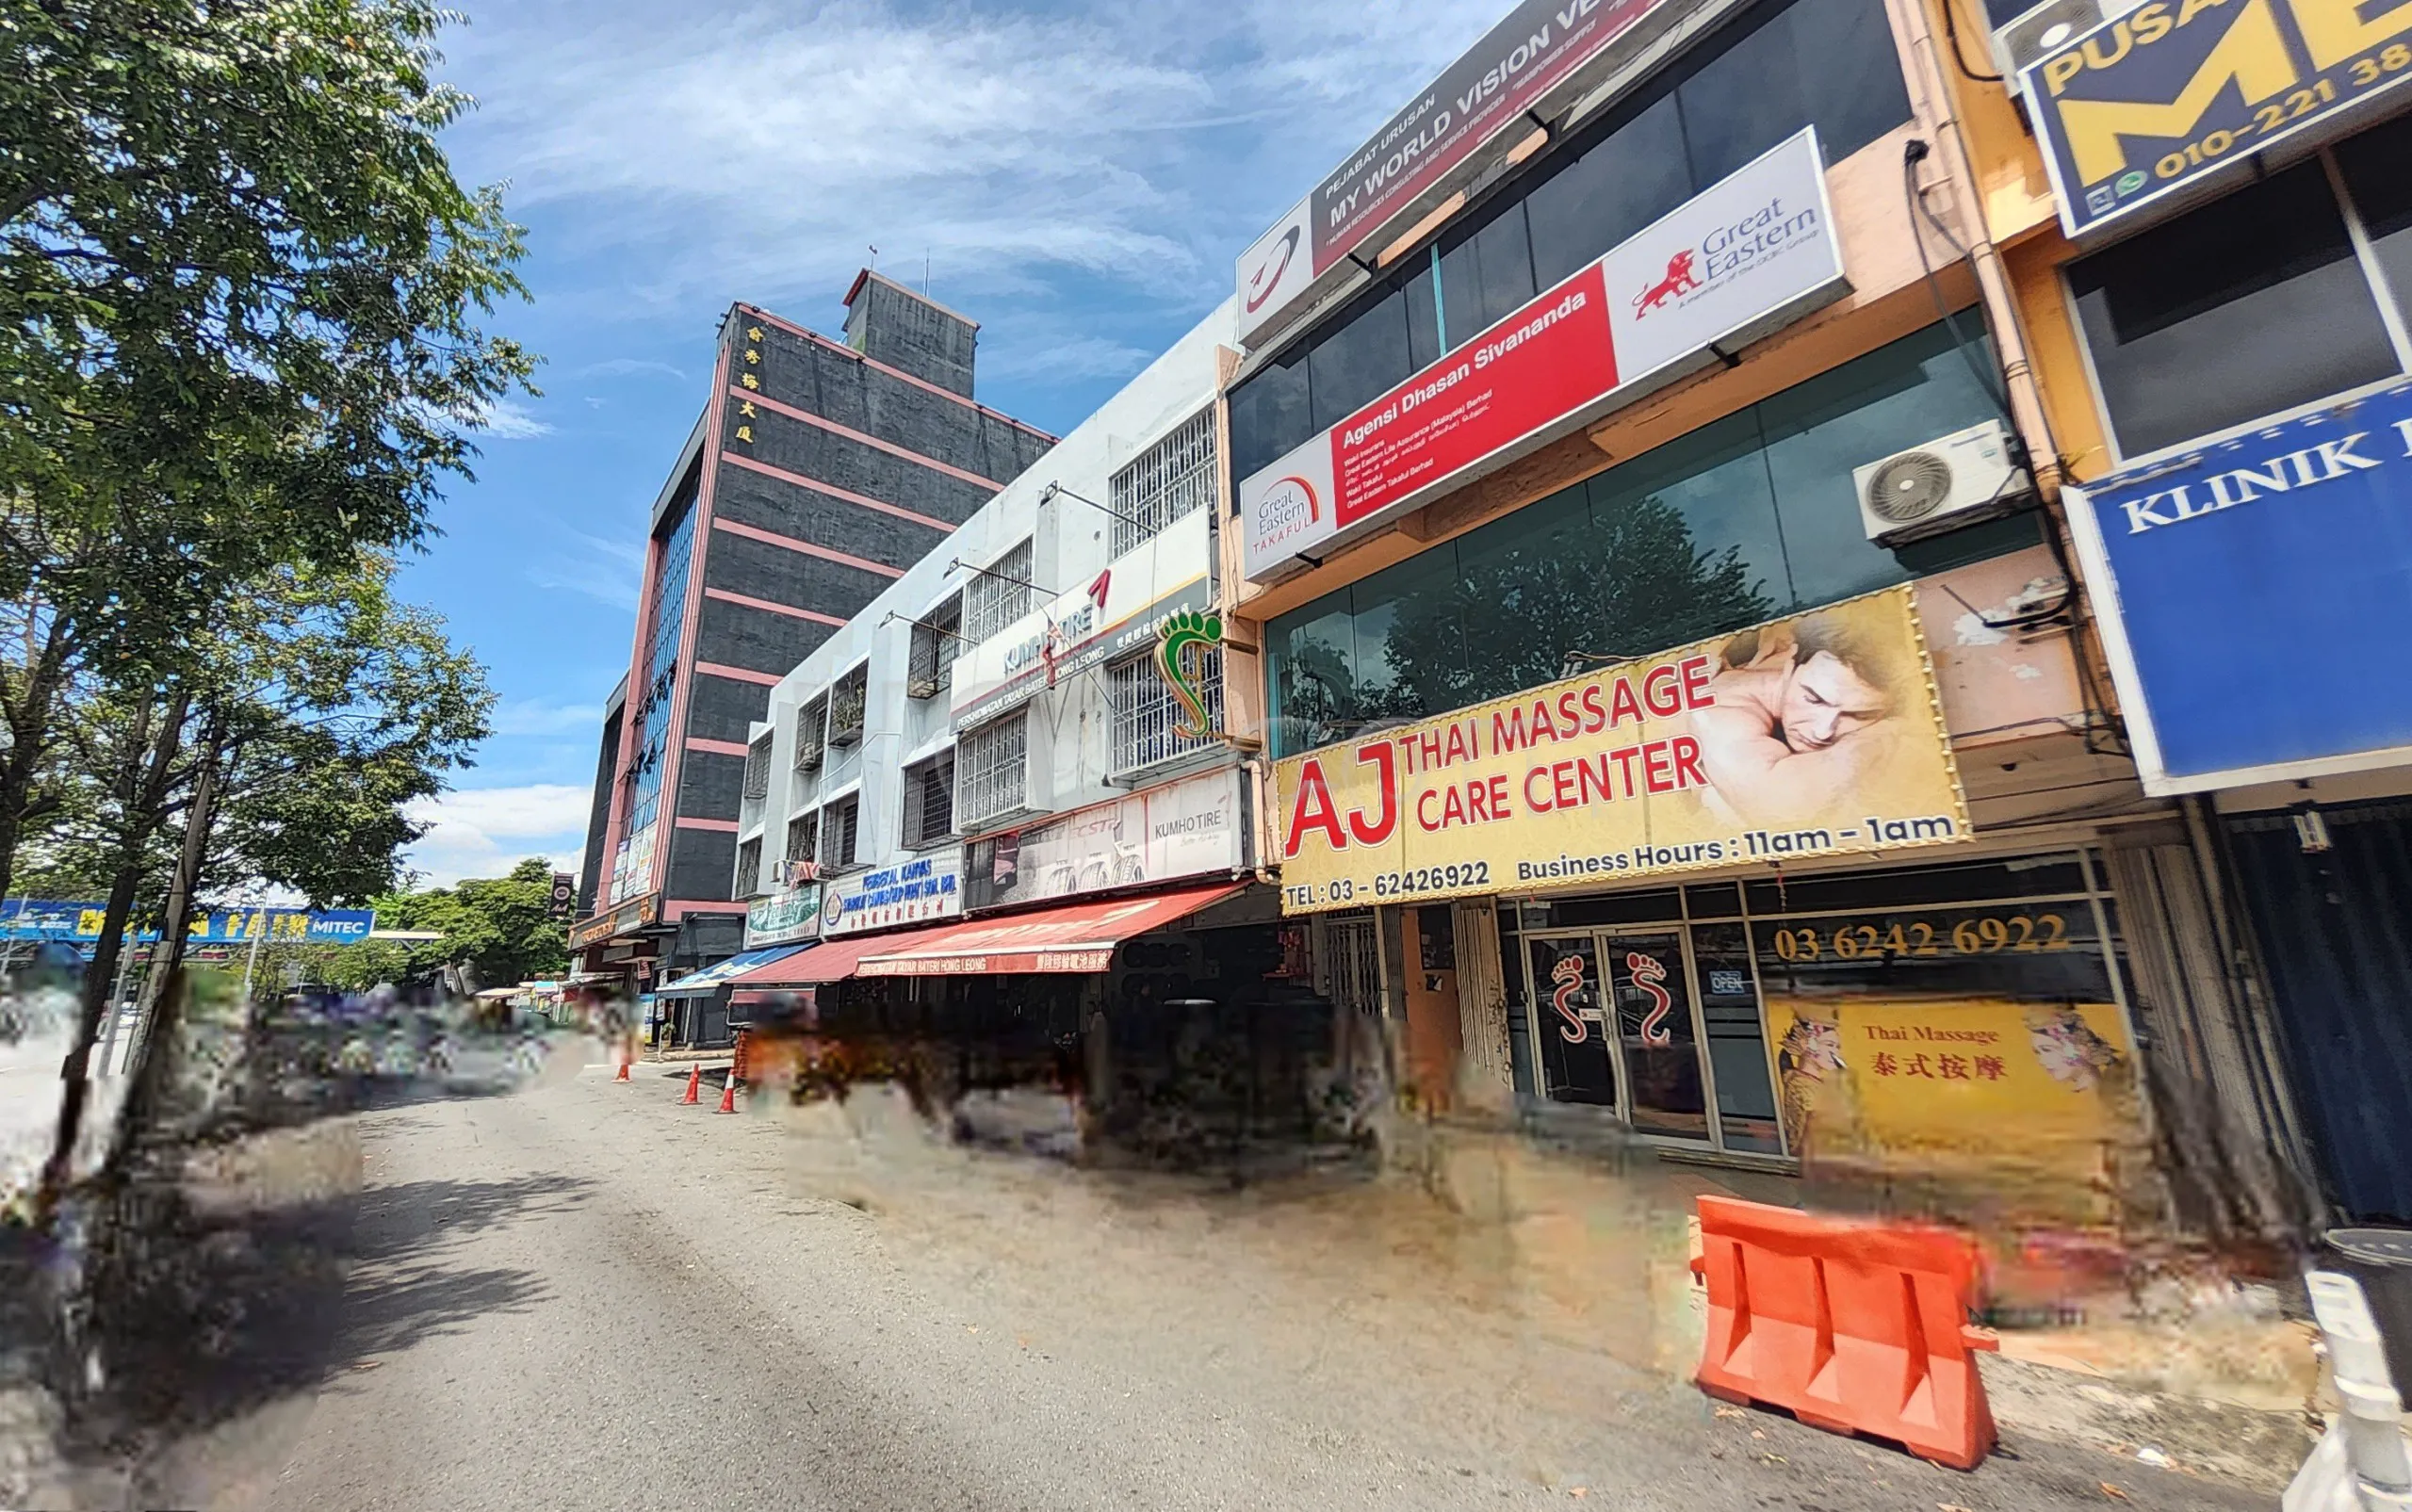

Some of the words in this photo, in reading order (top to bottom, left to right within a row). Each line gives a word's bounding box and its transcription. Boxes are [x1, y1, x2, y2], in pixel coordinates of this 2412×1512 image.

[1326, 145, 1378, 200] PEJABAT
[1380, 93, 1436, 149] URUSAN
[1330, 187, 1361, 228] MY
[1364, 110, 1451, 197] WORLD
[1456, 24, 1549, 115] VISION
[2155, 78, 2337, 179] 010-221
[1703, 197, 1785, 255] Great
[1705, 208, 1817, 281] Eastern
[1344, 402, 1398, 449] Agensi
[1401, 362, 1471, 415] Dhasan
[1474, 289, 1587, 370] Sivananda
[1259, 490, 1293, 518] Great
[2119, 431, 2386, 534] KLINIK
[1253, 517, 1310, 555] TAKAFUL
[1259, 502, 1305, 536] Eastern
[1398, 718, 1478, 775] THAI
[1491, 656, 1715, 756] MASSAGE
[1284, 740, 1397, 858] AJ
[1416, 774, 1512, 833] CARE
[1523, 735, 1709, 813] CENTER
[1155, 817, 1195, 839] KUMHO
[1196, 810, 1221, 829] TIRE
[1518, 850, 1628, 881] Business
[1867, 815, 1953, 843] 1am
[1375, 861, 1490, 896] 62426922
[312, 921, 365, 935] MITEC
[1775, 928, 1819, 962] 03
[1833, 922, 1938, 959] 6242
[1953, 914, 2069, 954] 6922
[940, 958, 960, 971] HONG
[961, 957, 986, 971] LEONG
[1712, 977, 1743, 989] OPEN
[1862, 1025, 1908, 1041] Thai
[1913, 1026, 2000, 1046] Massage
[1869, 1051, 2009, 1081] 泰式按摩
